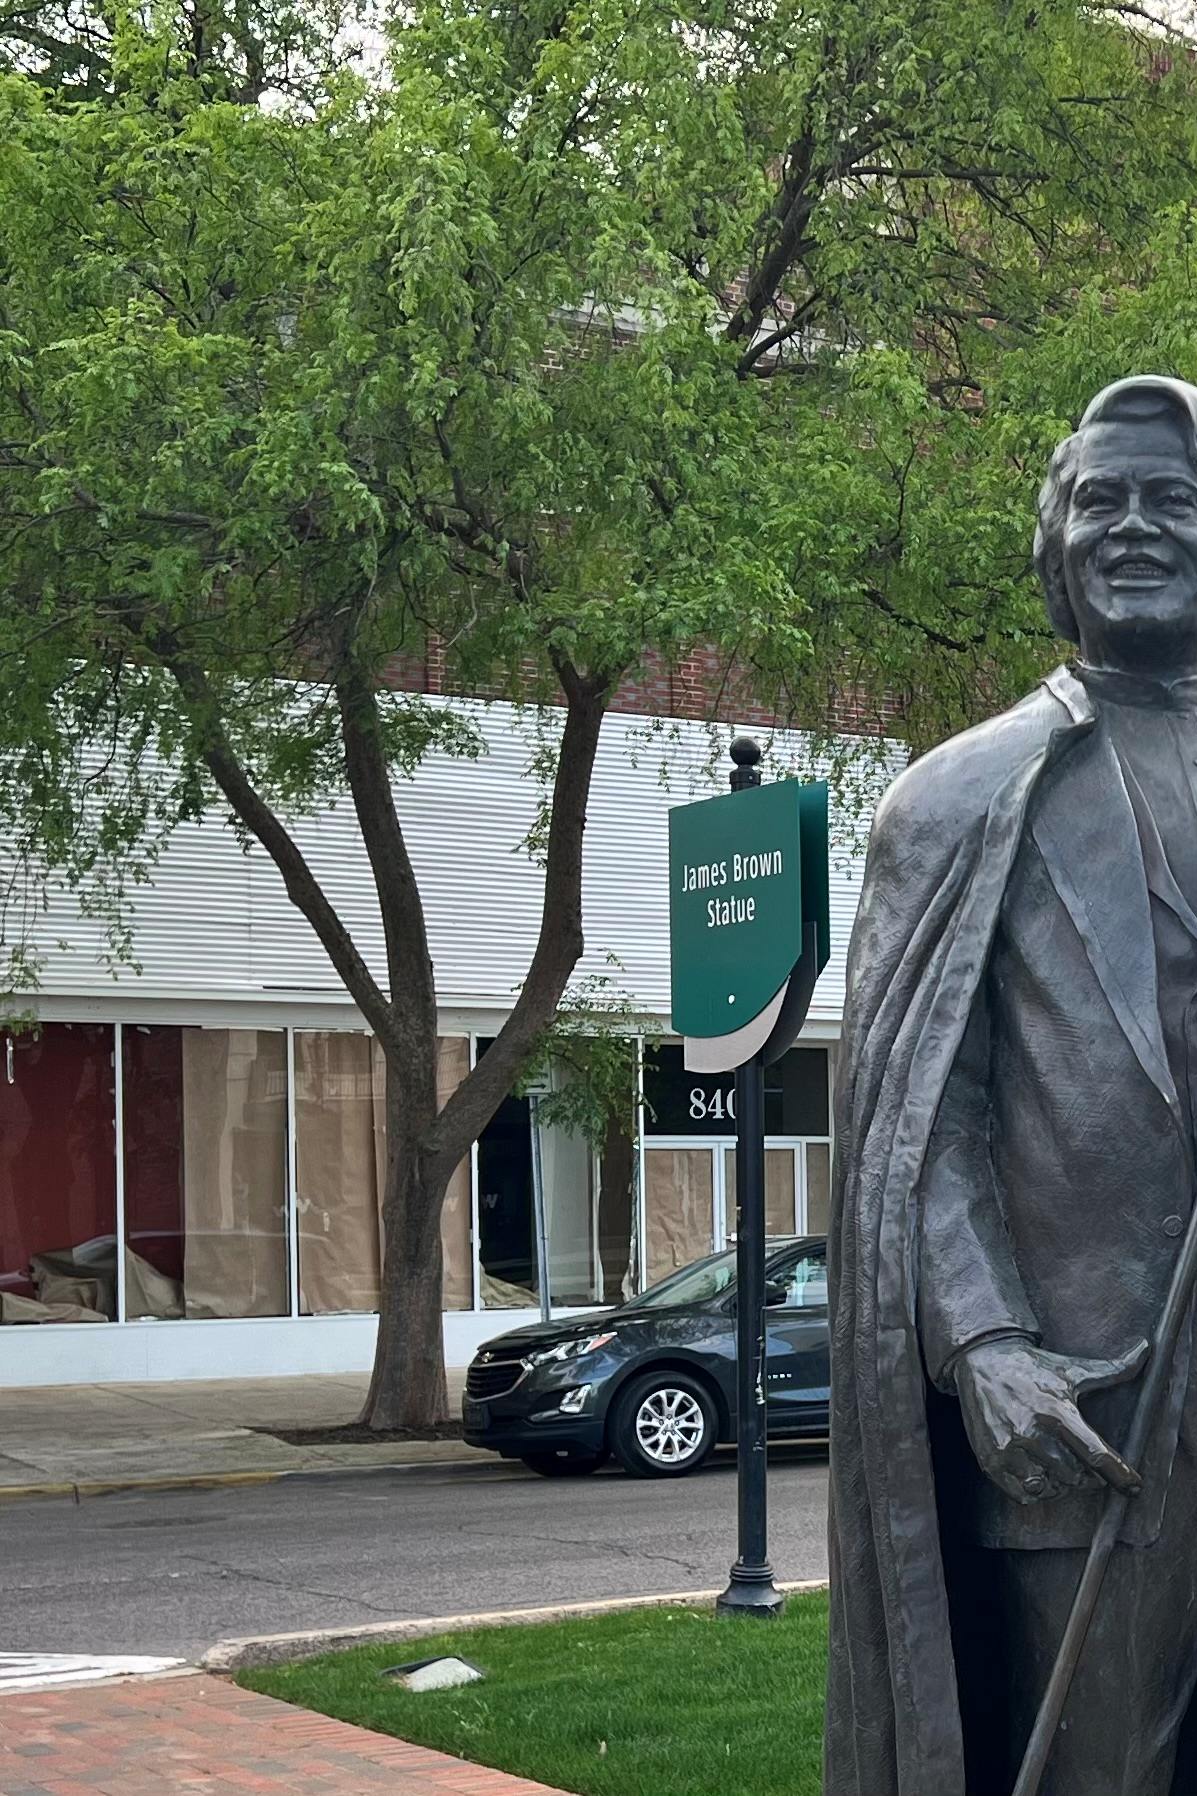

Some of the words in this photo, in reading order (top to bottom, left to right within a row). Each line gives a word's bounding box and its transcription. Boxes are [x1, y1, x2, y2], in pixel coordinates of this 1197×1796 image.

[682, 861, 727, 892] James
[733, 850, 782, 882] Brown
[707, 895, 755, 928] Statue
